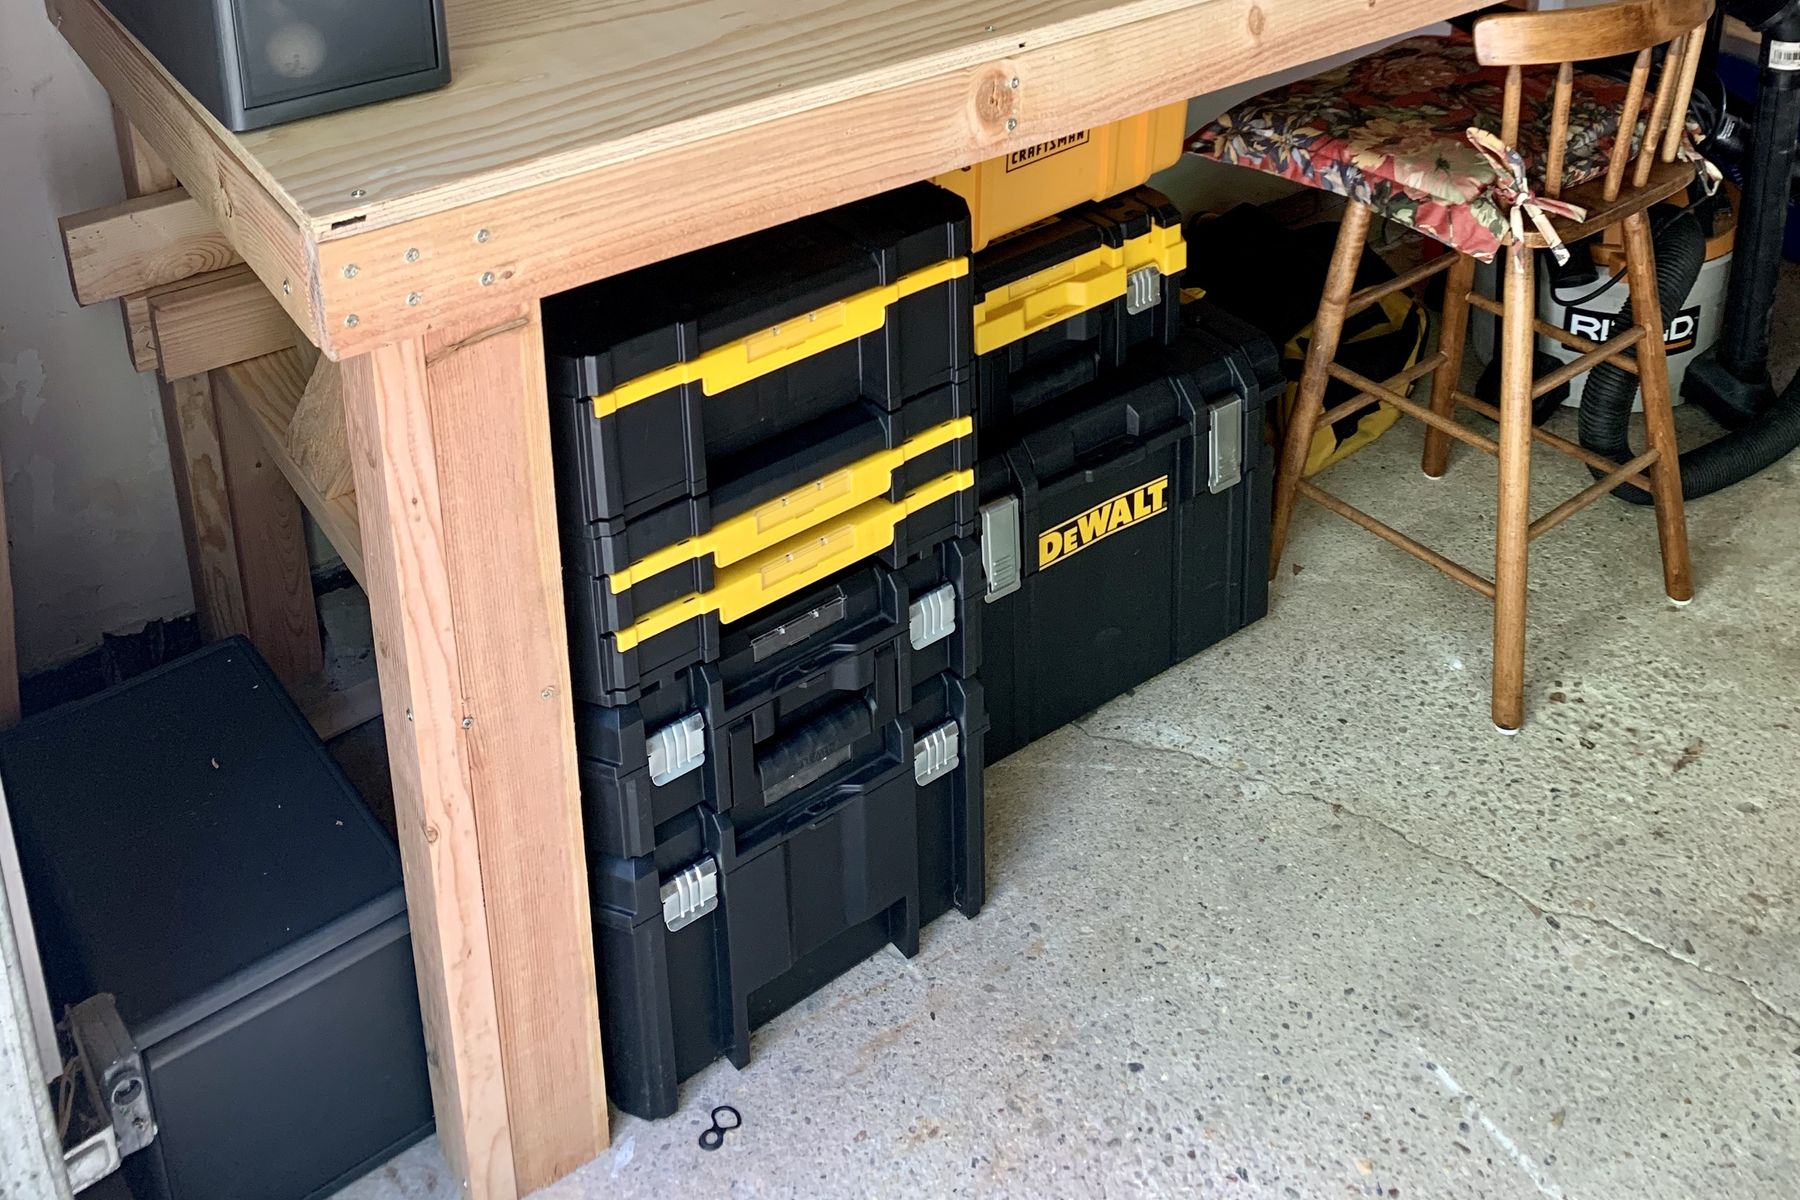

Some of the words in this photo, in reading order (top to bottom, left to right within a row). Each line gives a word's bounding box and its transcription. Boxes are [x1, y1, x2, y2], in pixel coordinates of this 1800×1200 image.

[1011, 130, 1084, 165] CRAFTSMAN
[1570, 313, 1694, 342] RID
[1039, 478, 1168, 567] DEWALT
